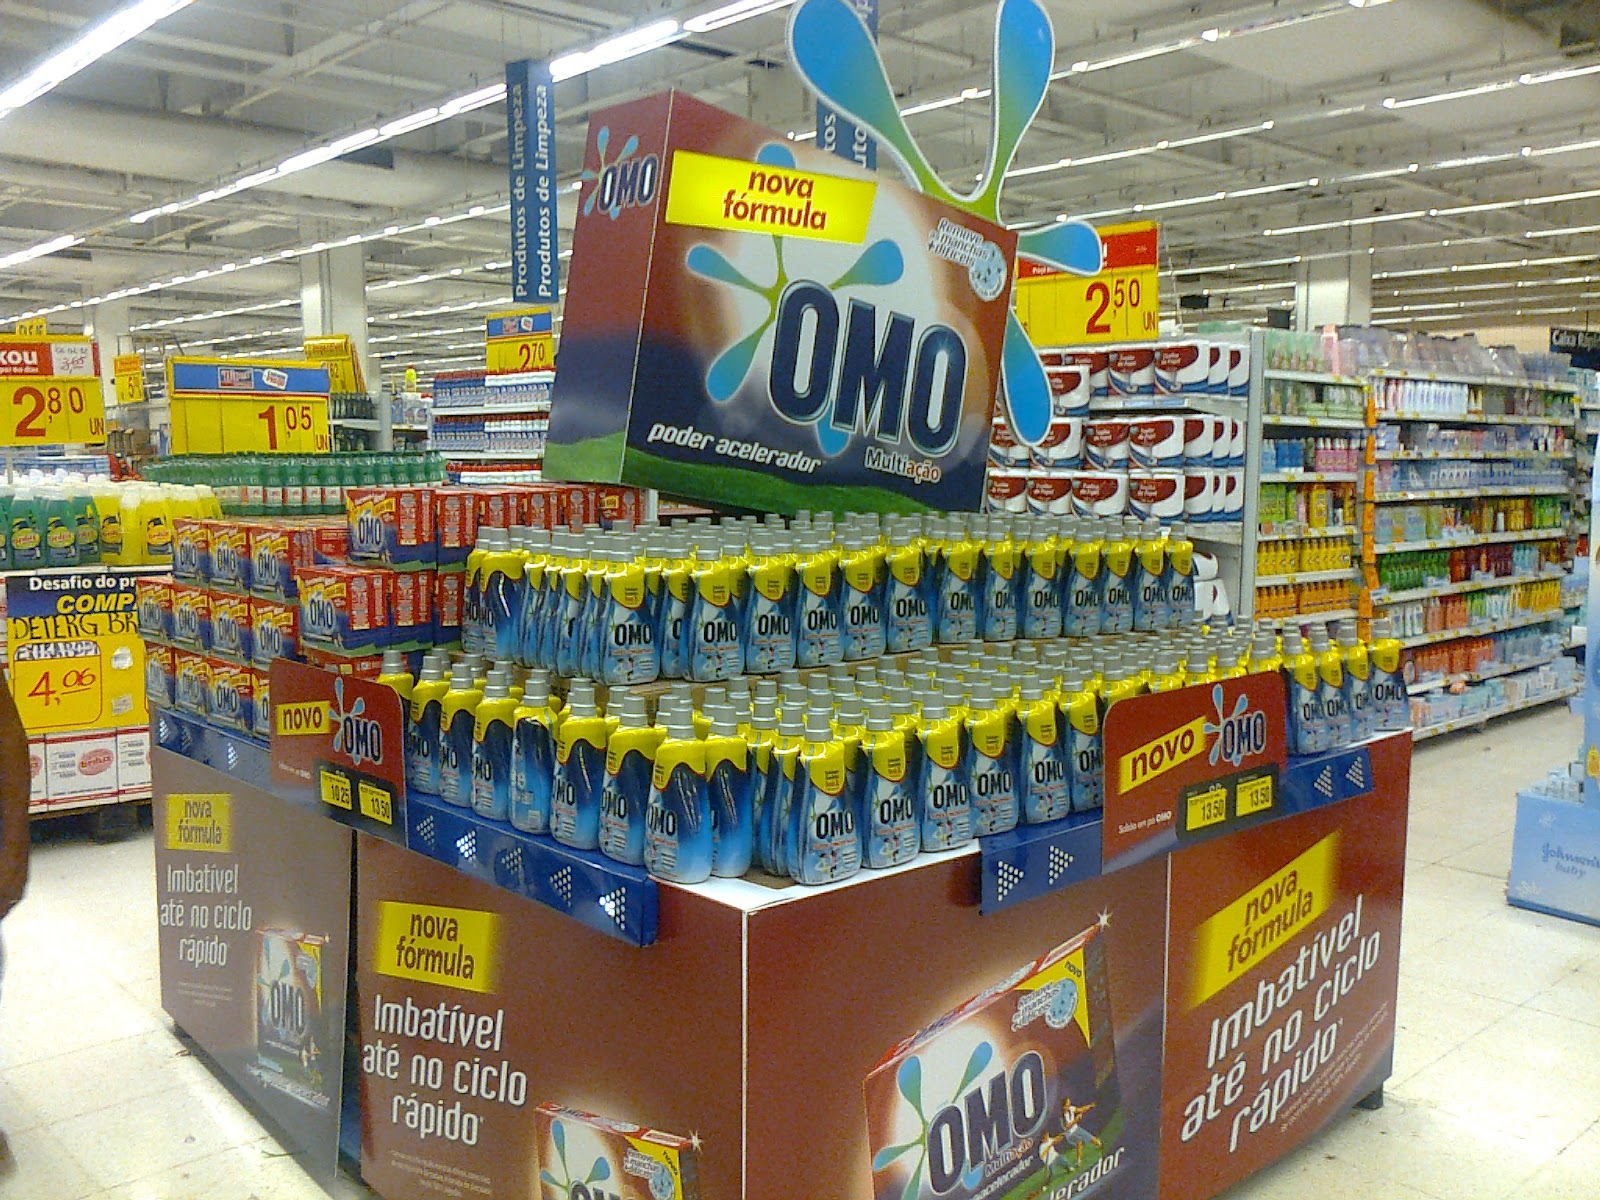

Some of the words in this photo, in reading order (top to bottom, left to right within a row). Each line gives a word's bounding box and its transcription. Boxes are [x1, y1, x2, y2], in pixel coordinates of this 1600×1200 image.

[512, 84, 525, 168] Limpeza
[535, 84, 550, 171] Limpeza
[515, 174, 525, 198] de
[536, 175, 549, 199] de
[599, 153, 659, 213] OMO
[747, 169, 815, 198] nova
[723, 189, 827, 231] fórmula
[514, 205, 528, 297] Produtos
[537, 207, 552, 298] Produtos
[1143, 311, 1156, 331] UN
[768, 279, 968, 458] OMO
[13, 386, 84, 437] 2,80
[90, 417, 104, 436] UN
[258, 405, 313, 450] 1,05
[317, 434, 329, 451] UN
[647, 423, 714, 450] poder
[715, 437, 821, 474] acelerador
[865, 446, 941, 483] Multiação
[359, 517, 381, 545] OMO
[29, 576, 92, 591] Desafio
[96, 575, 117, 588] do
[57, 593, 138, 614] COMP
[808, 609, 837, 631] OMO
[851, 605, 879, 626] OMO
[896, 598, 926, 618] OMO
[614, 623, 650, 647] OMO
[704, 621, 738, 644] OMO
[758, 614, 790, 636] OMO
[282, 706, 322, 732] novo
[343, 715, 383, 765] OMO
[1130, 728, 1195, 782] novo
[1221, 710, 1266, 762] OMO
[977, 770, 1012, 797] OMO
[1034, 759, 1064, 784] OMO
[184, 799, 212, 819] nova
[602, 789, 627, 820] OMO
[880, 798, 914, 825] OMO
[933, 783, 967, 810] OMO
[178, 819, 222, 845] fórmula
[649, 804, 676, 837] OMO
[816, 811, 854, 839] OMO
[1156, 810, 1172, 823] OMO
[167, 863, 239, 895] Imbatível
[1244, 869, 1298, 926] nova
[161, 899, 184, 927] até
[190, 904, 209, 927] no
[214, 900, 251, 931] ciclo
[410, 912, 458, 942] nova
[1228, 889, 1313, 973] fórmula
[179, 935, 228, 968] rápido
[396, 936, 474, 980] fórmula
[1207, 894, 1363, 1069] Imbatível
[271, 979, 305, 1037] OMO
[374, 994, 504, 1051] Imbatível
[1181, 1052, 1247, 1143] até
[1262, 1009, 1302, 1075] no
[1313, 931, 1381, 1022] ciclo
[362, 1044, 399, 1080] até
[411, 1054, 442, 1090] no
[454, 1057, 527, 1107] ciclo
[1229, 1022, 1338, 1154] rápido
[391, 1092, 478, 1146] rápido
[927, 1051, 1047, 1195] OMO
